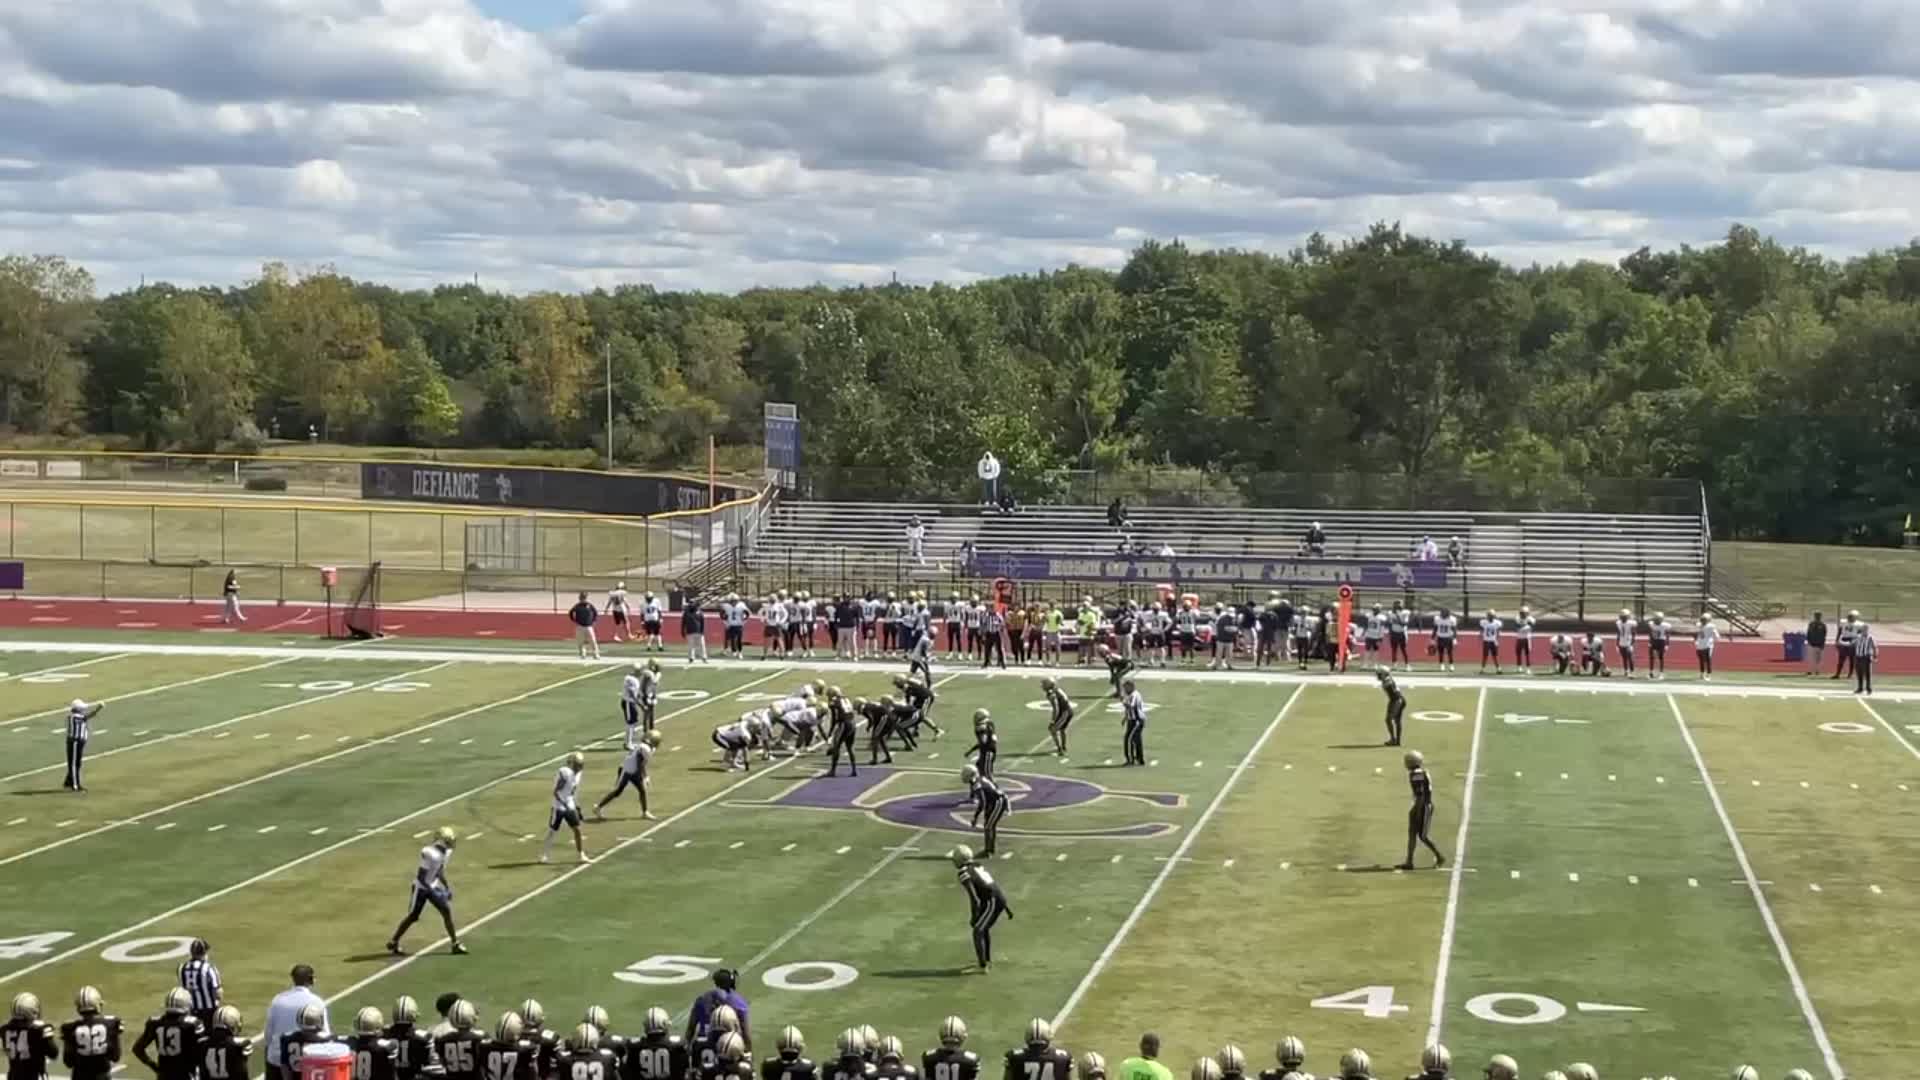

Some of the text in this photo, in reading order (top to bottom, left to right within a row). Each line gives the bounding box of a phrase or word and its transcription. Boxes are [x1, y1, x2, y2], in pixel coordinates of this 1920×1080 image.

[412, 469, 480, 499] DEFIANCE
[5, 1030, 30, 1059] 54
[75, 1025, 107, 1055] 92
[155, 1026, 181, 1056] 13
[205, 1048, 228, 1079] 41
[445, 1041, 474, 1072] 95
[488, 1051, 518, 1080] 97
[640, 1048, 670, 1079] 90
